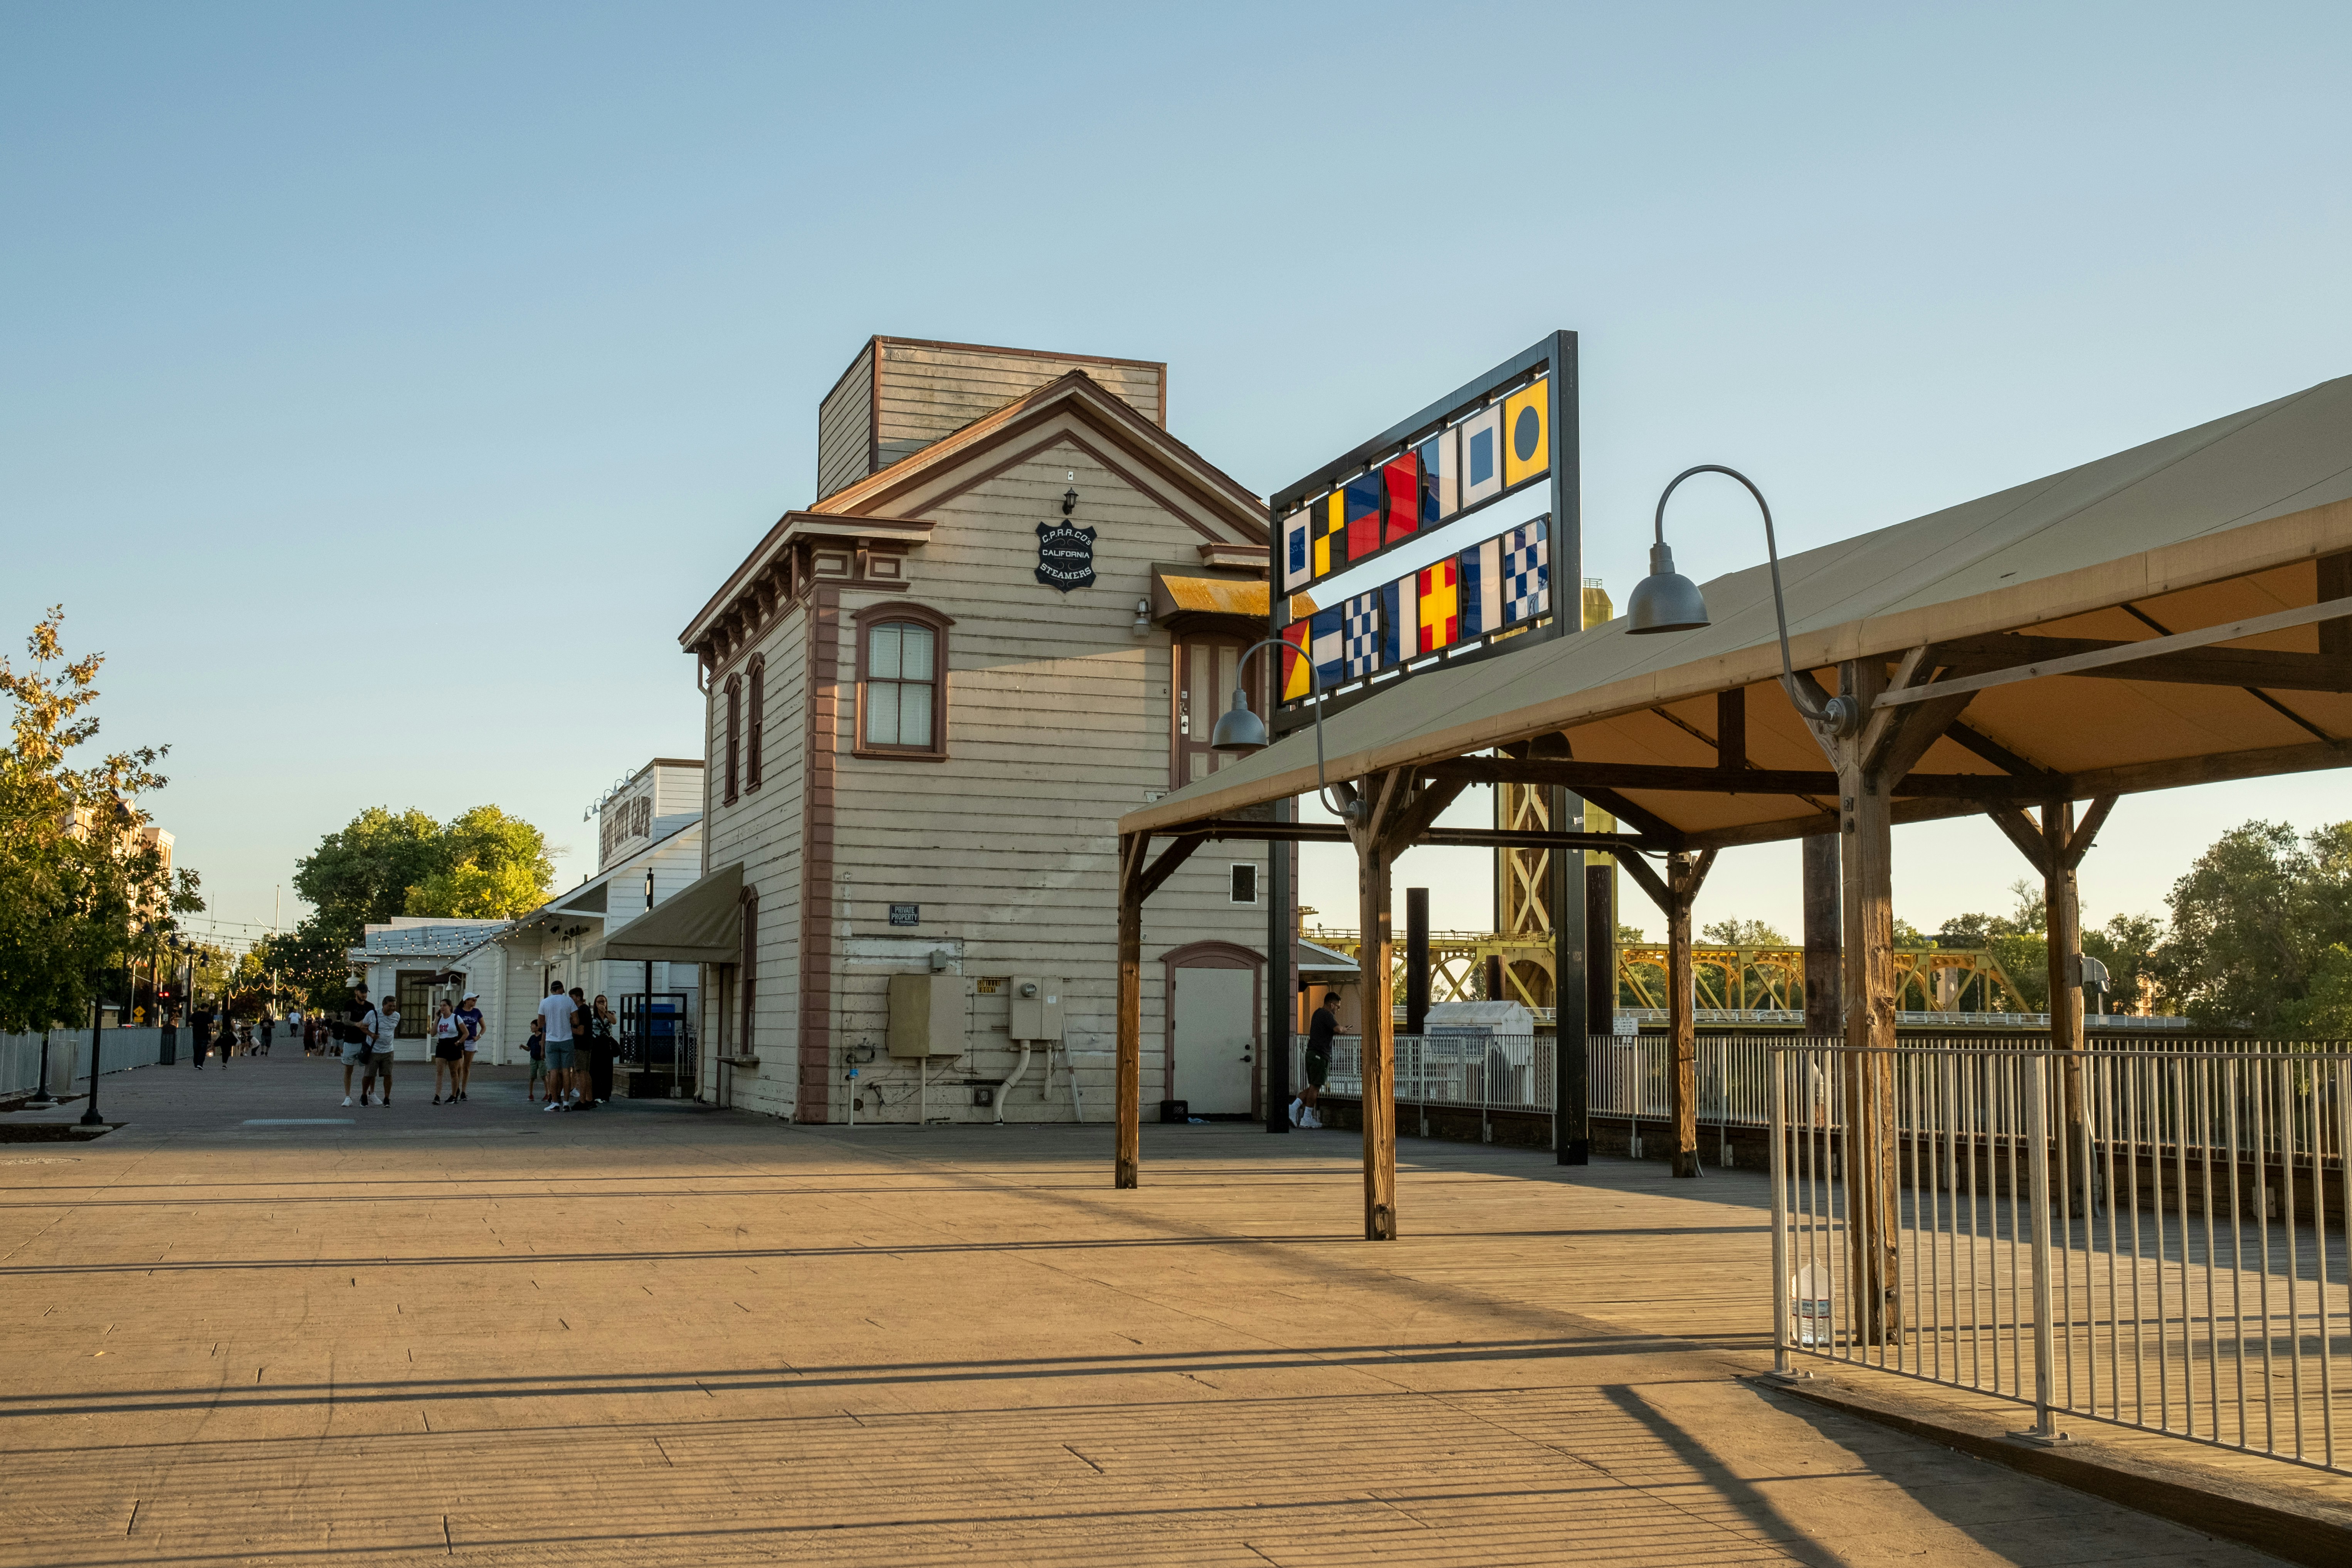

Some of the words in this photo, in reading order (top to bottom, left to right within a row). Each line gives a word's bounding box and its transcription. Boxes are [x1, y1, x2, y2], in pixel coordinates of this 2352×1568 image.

[1042, 550, 1090, 559] CALIFORNIA
[1040, 563, 1092, 579] STEAMERS
[614, 800, 630, 847] CITY
